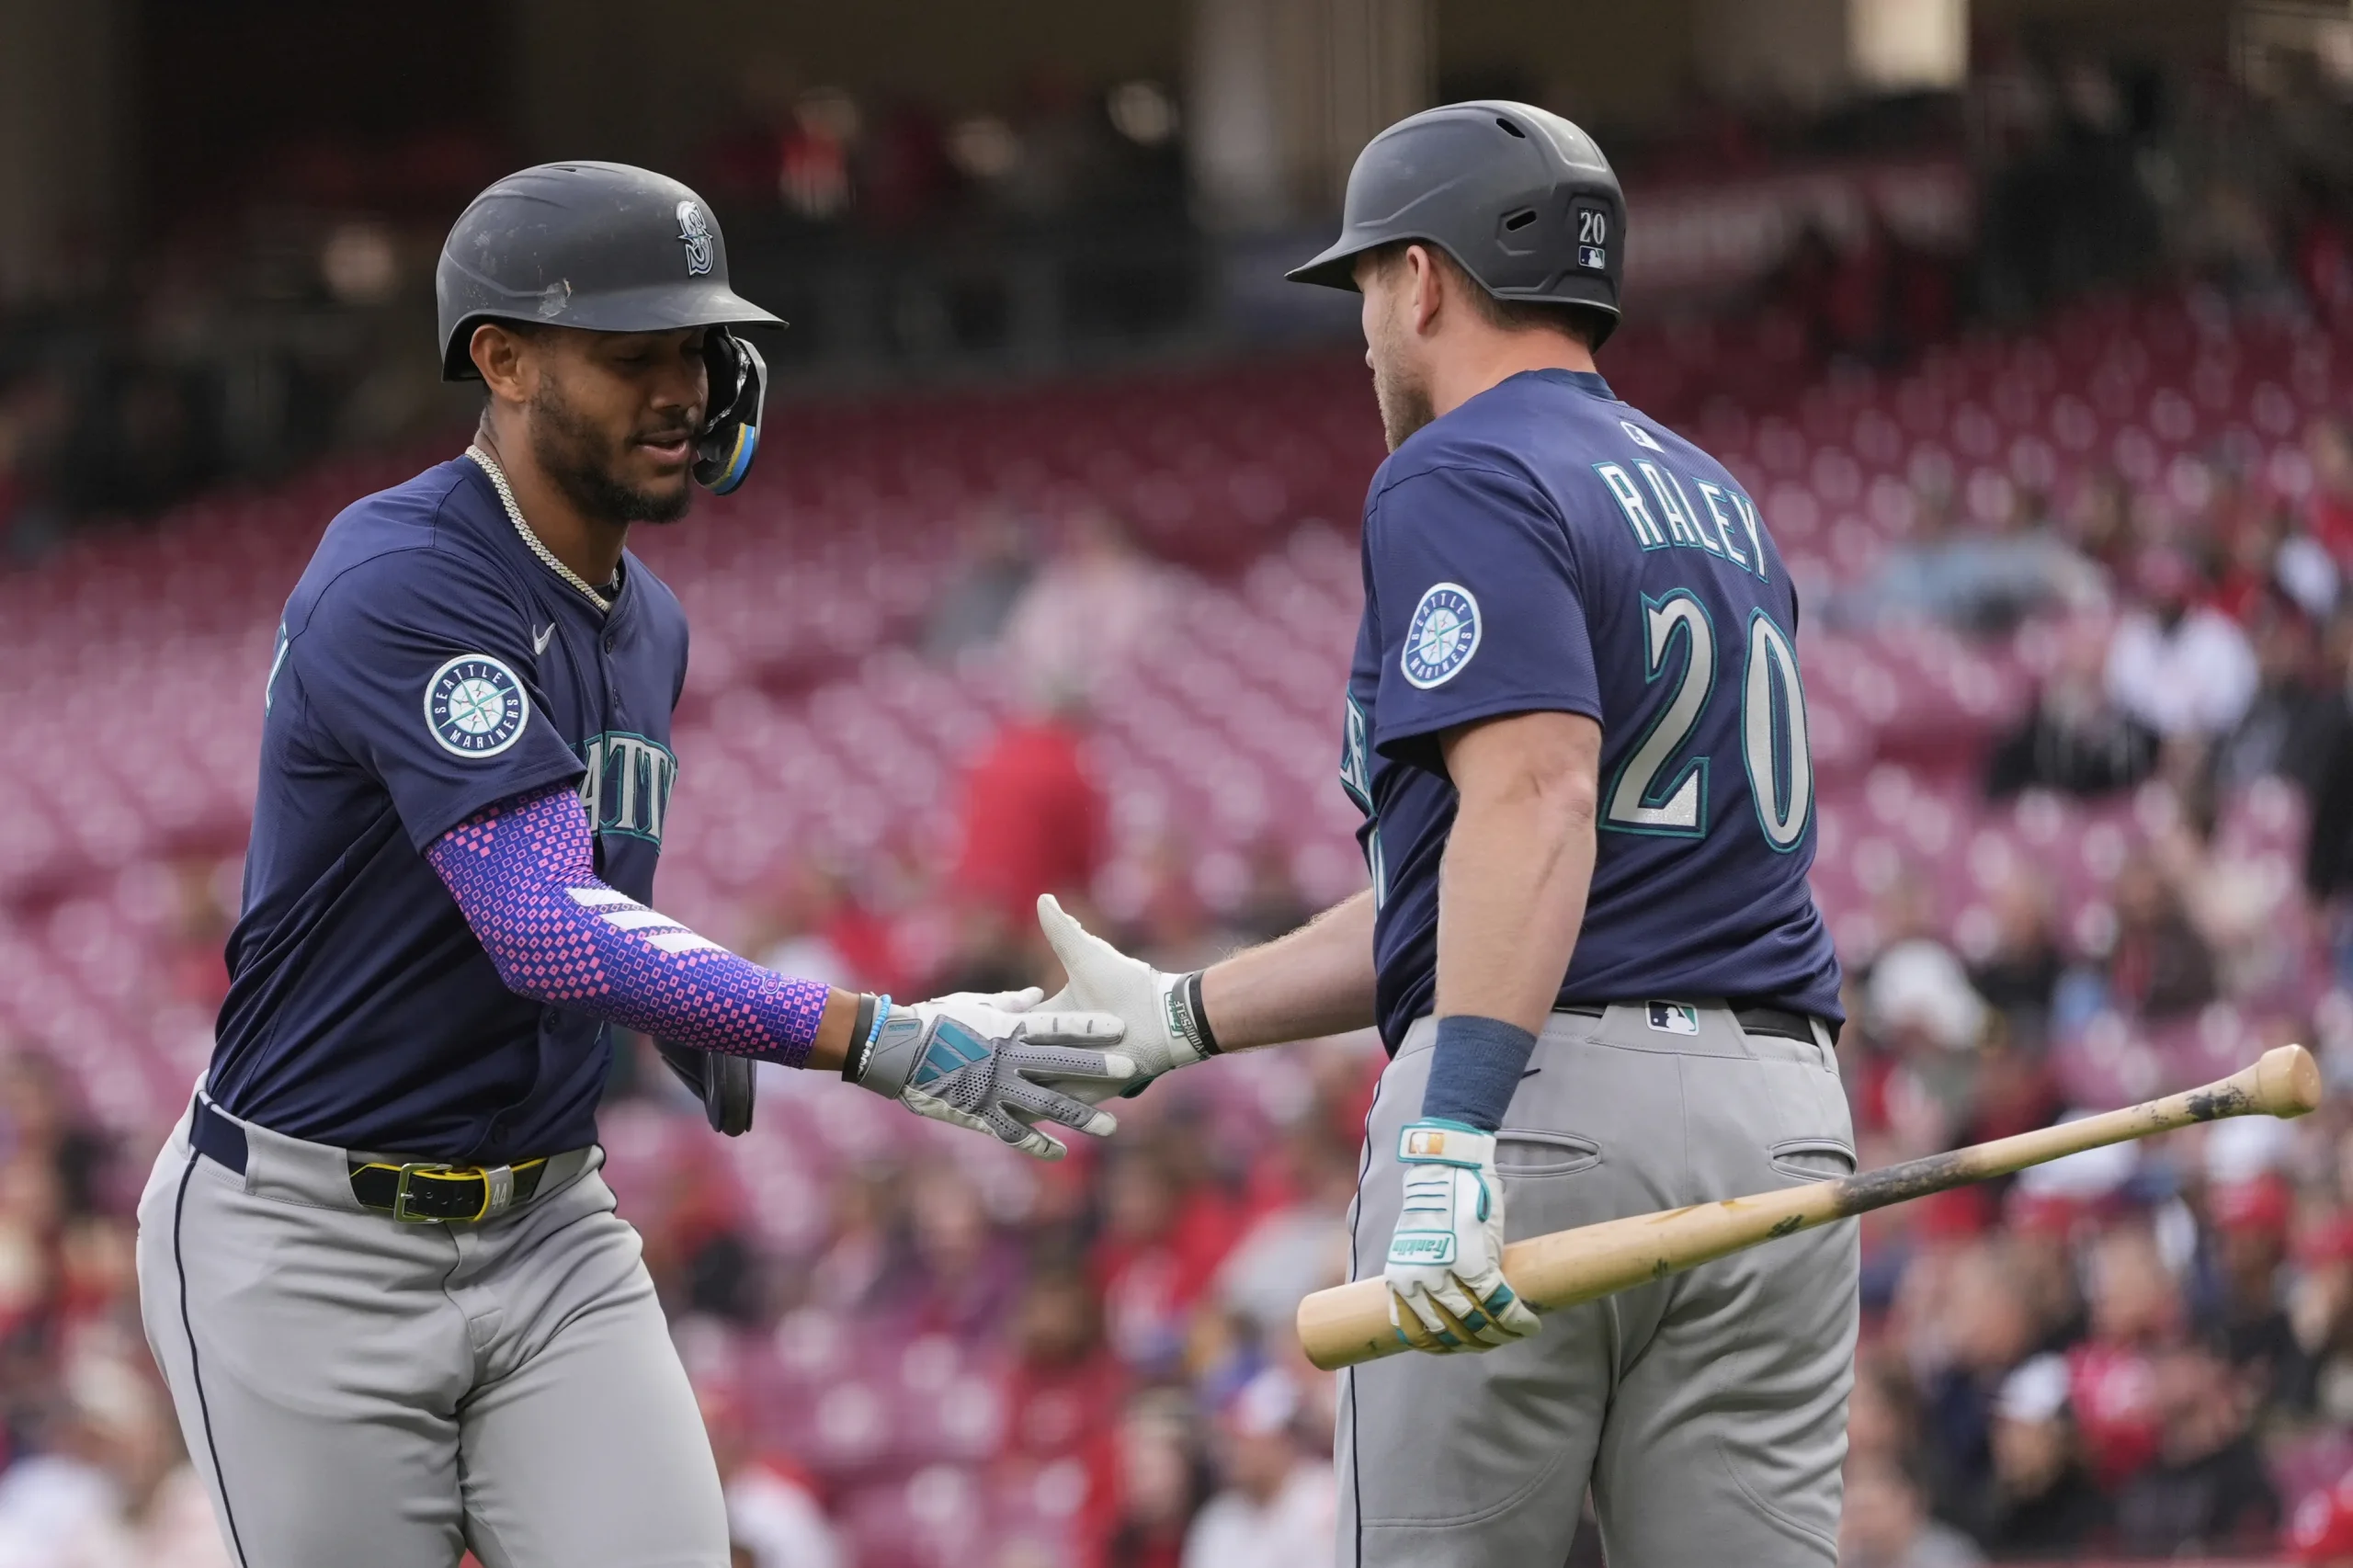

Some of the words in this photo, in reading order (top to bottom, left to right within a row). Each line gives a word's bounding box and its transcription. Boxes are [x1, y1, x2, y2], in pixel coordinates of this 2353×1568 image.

[1580, 211, 1606, 244] 20
[1591, 458, 1769, 585] RALEY
[1411, 593, 1467, 641] SEATTLE
[1409, 631, 1472, 679] MARINERS
[435, 663, 503, 713] SEATTLE
[449, 699, 519, 749] MARINERS
[1598, 587, 1814, 853] 20
[492, 1183, 507, 1210] 44
